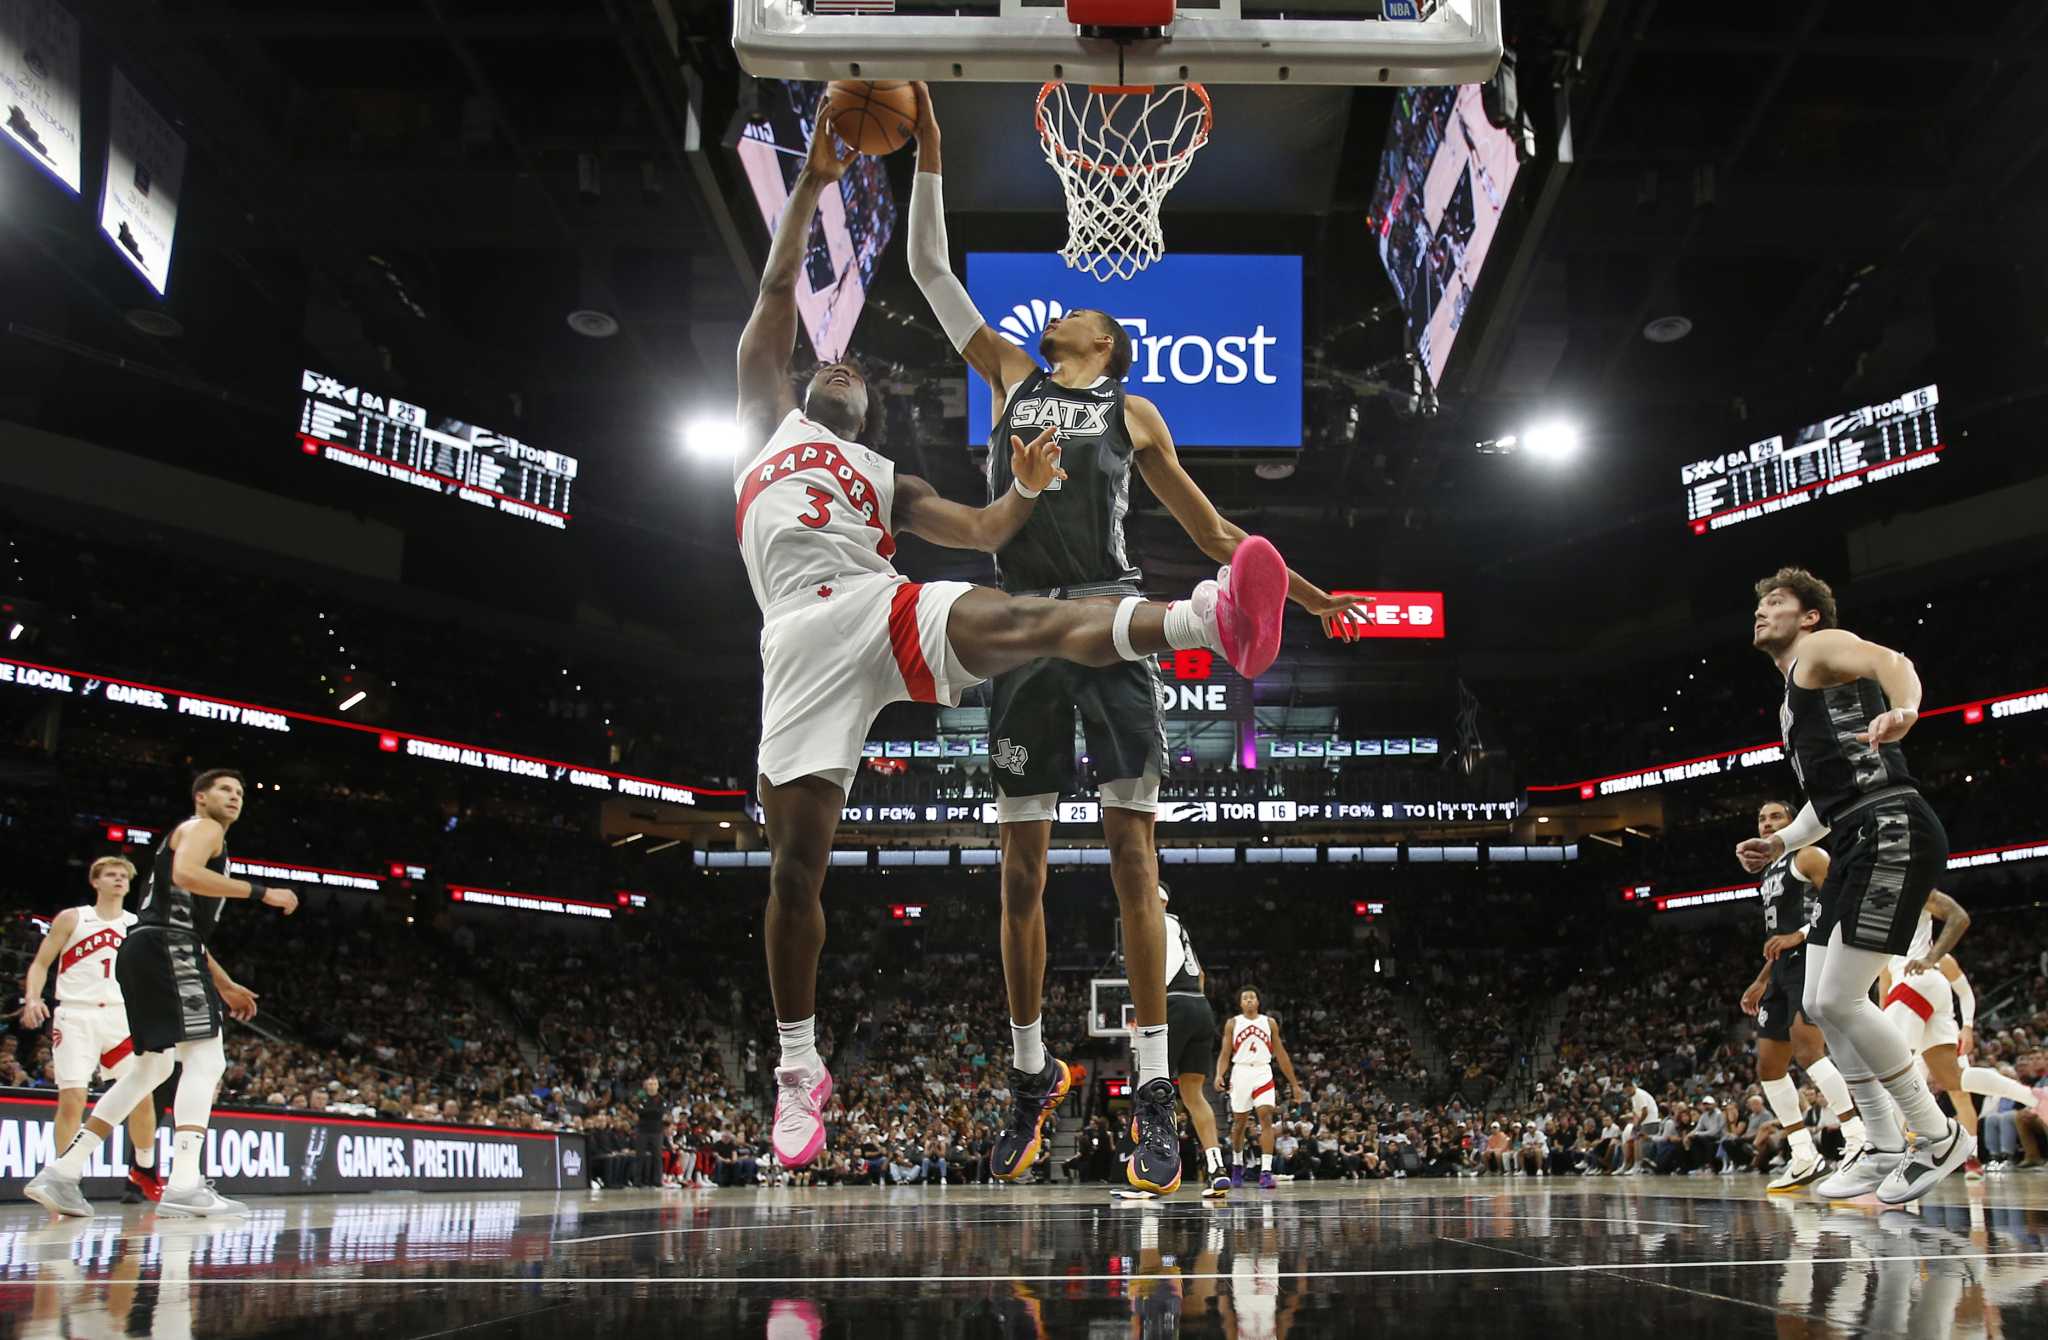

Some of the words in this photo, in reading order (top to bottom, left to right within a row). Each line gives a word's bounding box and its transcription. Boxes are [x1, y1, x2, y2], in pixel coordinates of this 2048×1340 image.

[1390, 3, 1410, 17] NBA
[1115, 318, 1277, 385] Frost
[361, 392, 385, 412] SA
[397, 404, 416, 422] 25
[1010, 397, 1114, 436] SATX
[1872, 399, 1902, 420] TOR
[1912, 390, 1929, 406] 16
[519, 443, 546, 465] TOR
[1727, 450, 1748, 467] SA
[1757, 440, 1775, 457] 25
[759, 446, 874, 522] RAPTORS
[797, 485, 834, 529] 3
[16, 666, 73, 692] LOCAL
[106, 683, 168, 710] GAMES.
[178, 696, 241, 723] PRETTY
[241, 708, 290, 732] MUCH.
[407, 739, 460, 763] STREAM
[460, 749, 485, 768] ALL
[485, 753, 510, 772] THE
[511, 758, 549, 779] LOCAL
[569, 769, 612, 791] GAMES.
[618, 778, 661, 799] PRETTY
[1600, 773, 1642, 795] STREAM
[1643, 770, 1663, 786] ALL
[1662, 766, 1685, 783] THE
[1685, 759, 1721, 779] LOCAL
[1740, 746, 1784, 768] GAMES.
[879, 807, 916, 820] FG%
[947, 807, 968, 820] PF
[1070, 805, 1087, 820] 25
[1220, 803, 1255, 819] TOR
[1270, 804, 1286, 819] 16
[1298, 804, 1319, 817] PF
[1338, 804, 1374, 818] FG%
[1403, 804, 1426, 817] TO
[75, 932, 123, 957] RAPTO
[101, 958, 111, 978] 1
[1249, 1041, 1257, 1054] 4
[0, 1119, 56, 1178] AM
[206, 1128, 290, 1178] LOCAL
[336, 1134, 411, 1179] GAMES.
[412, 1138, 478, 1178] PRETTY
[477, 1142, 523, 1179] MUCH.
